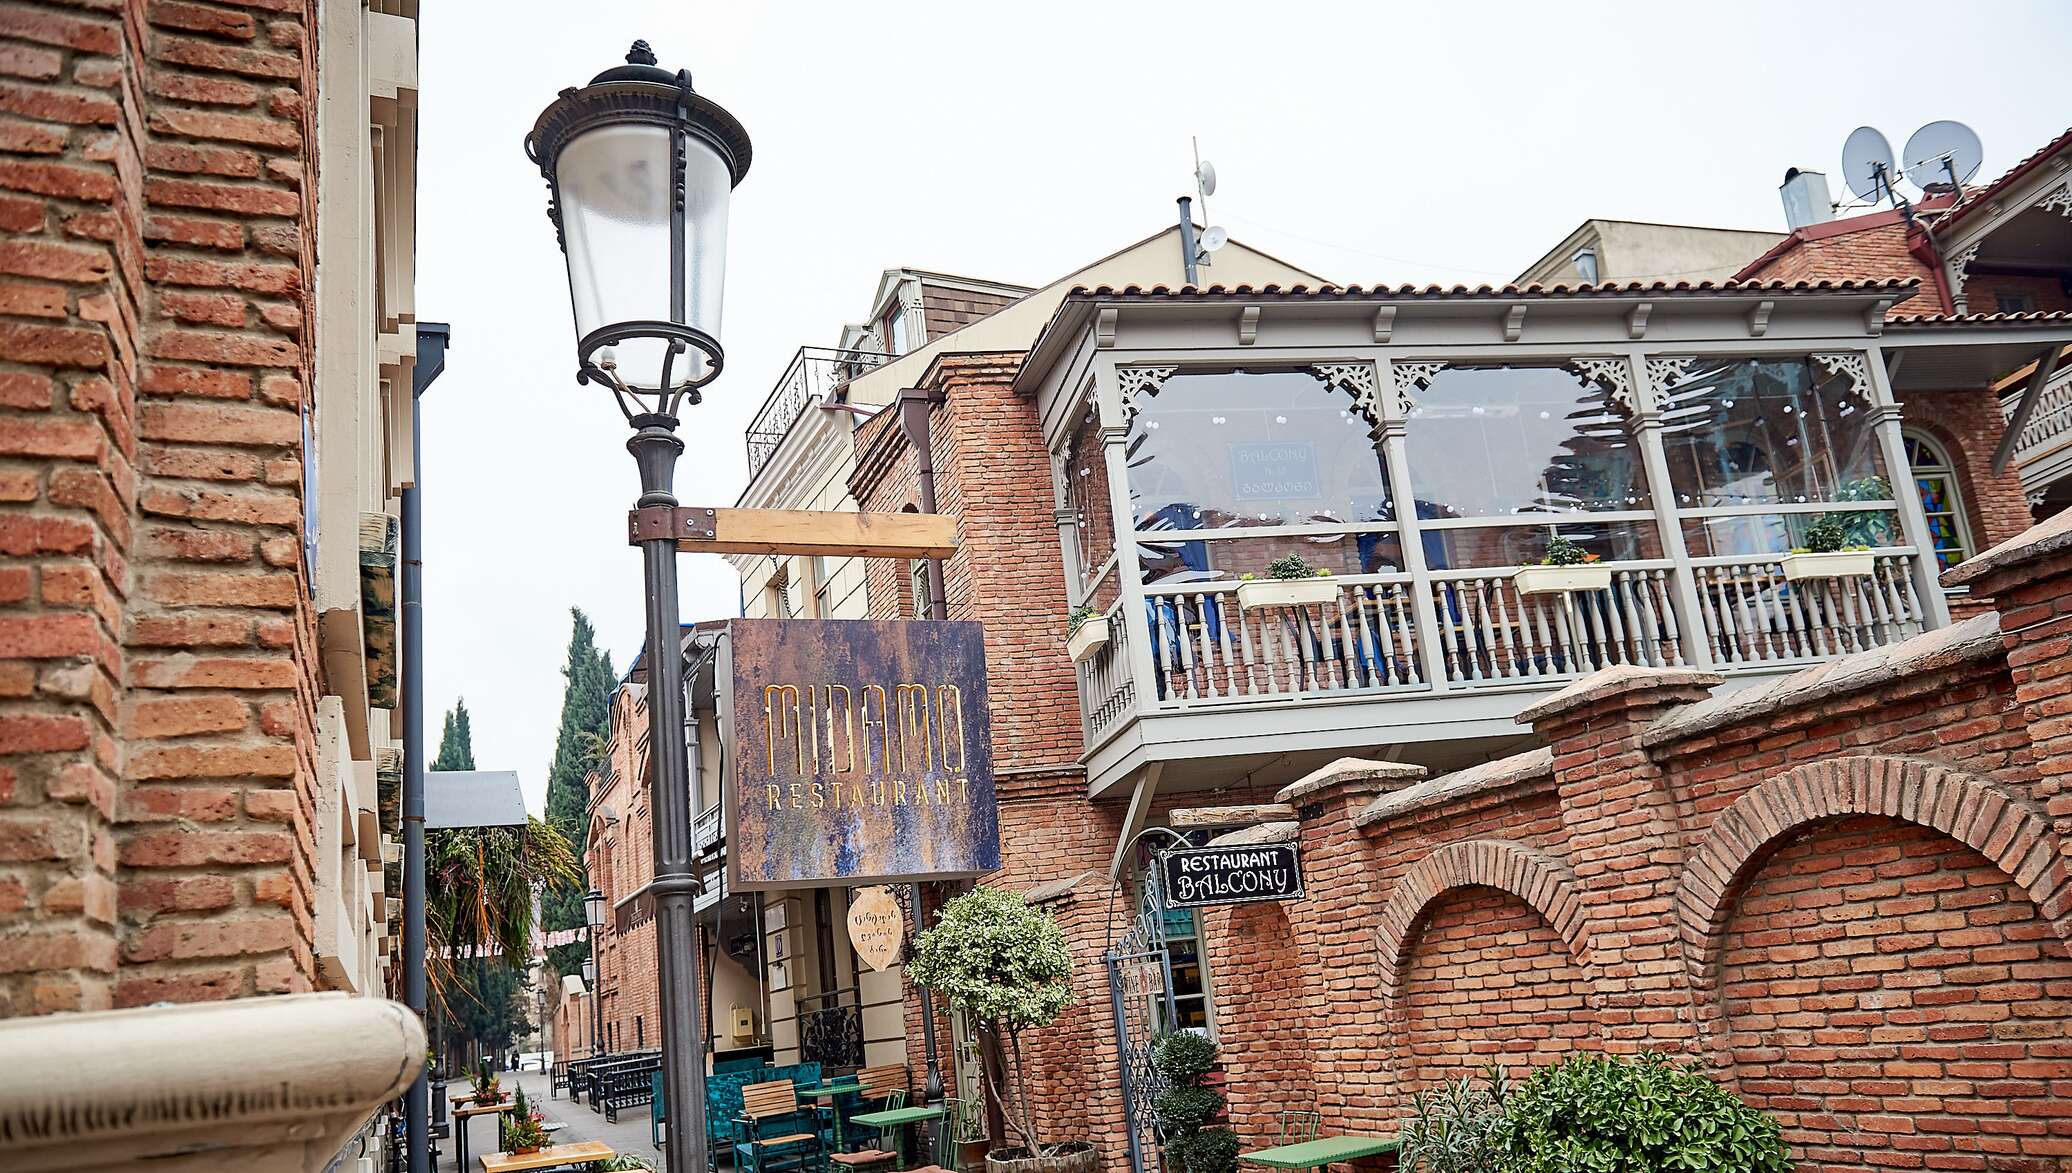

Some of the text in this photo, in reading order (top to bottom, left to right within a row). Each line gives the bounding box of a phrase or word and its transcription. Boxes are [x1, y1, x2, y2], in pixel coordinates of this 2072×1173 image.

[1240, 447, 1307, 463] BALCONY
[763, 684, 966, 777] MIDAMO
[767, 778, 970, 811] RESTAURANT
[1180, 851, 1279, 873] RESTAURANT
[1177, 868, 1288, 900] BALCONY
[1148, 971, 1163, 993] BAR
